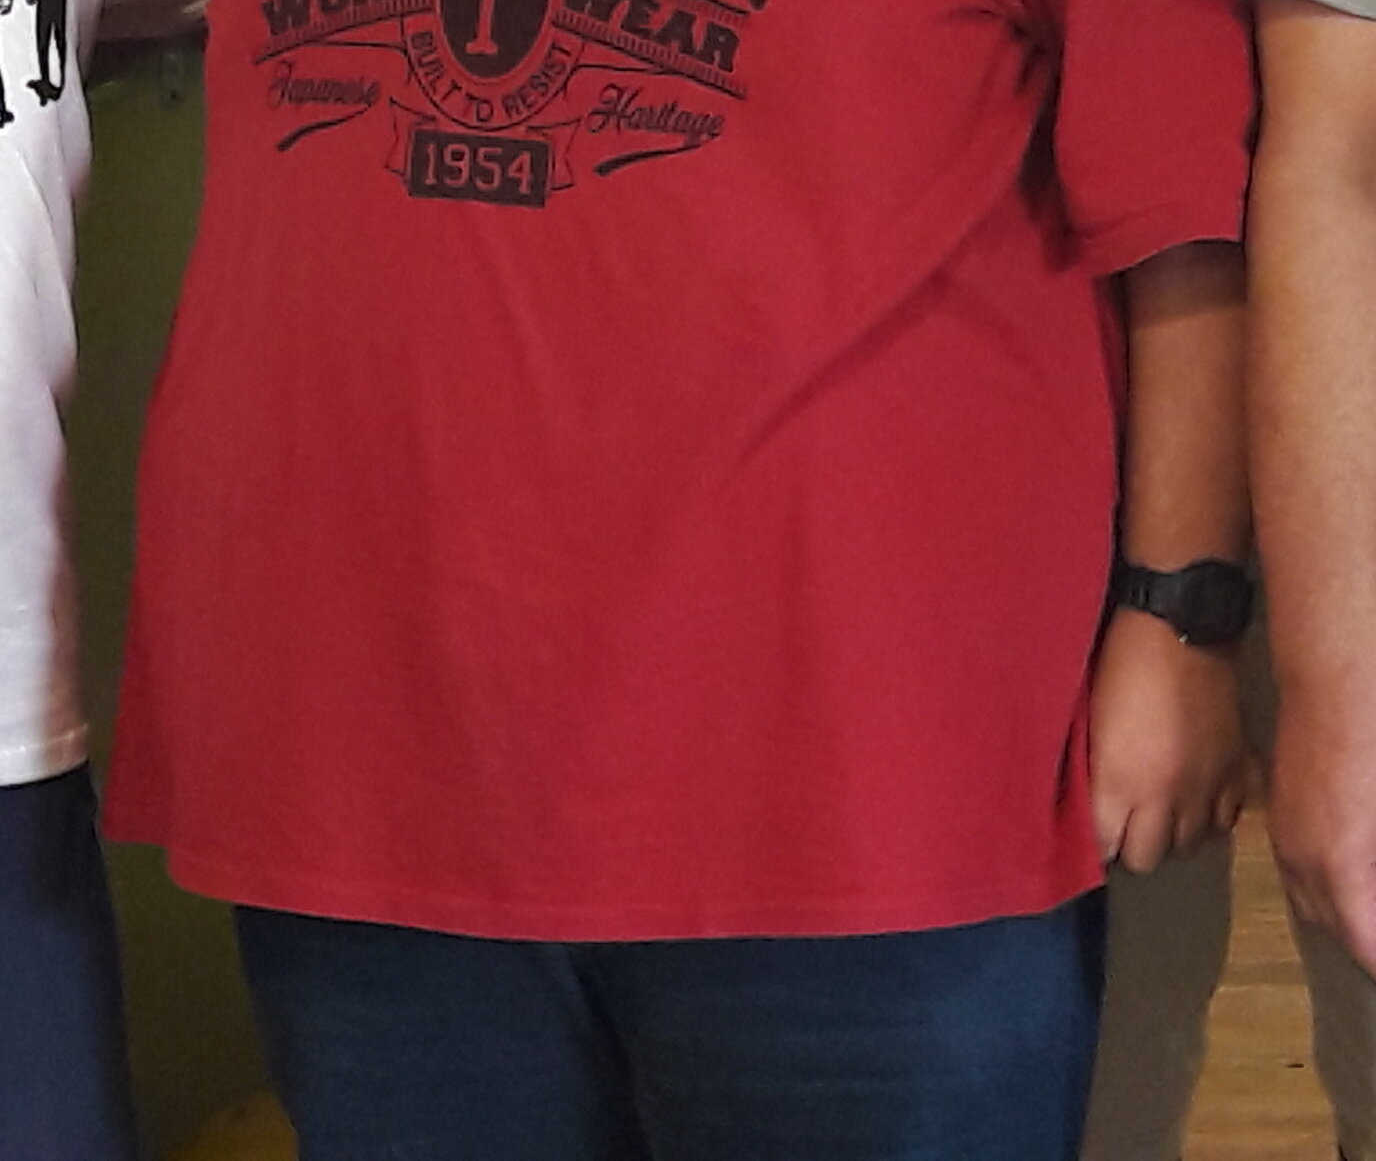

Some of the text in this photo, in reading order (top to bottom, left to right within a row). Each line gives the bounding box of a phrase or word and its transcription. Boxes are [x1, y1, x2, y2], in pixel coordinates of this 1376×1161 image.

[411, 31, 572, 122] BUILT TO RESIST
[423, 143, 535, 196] 1954
